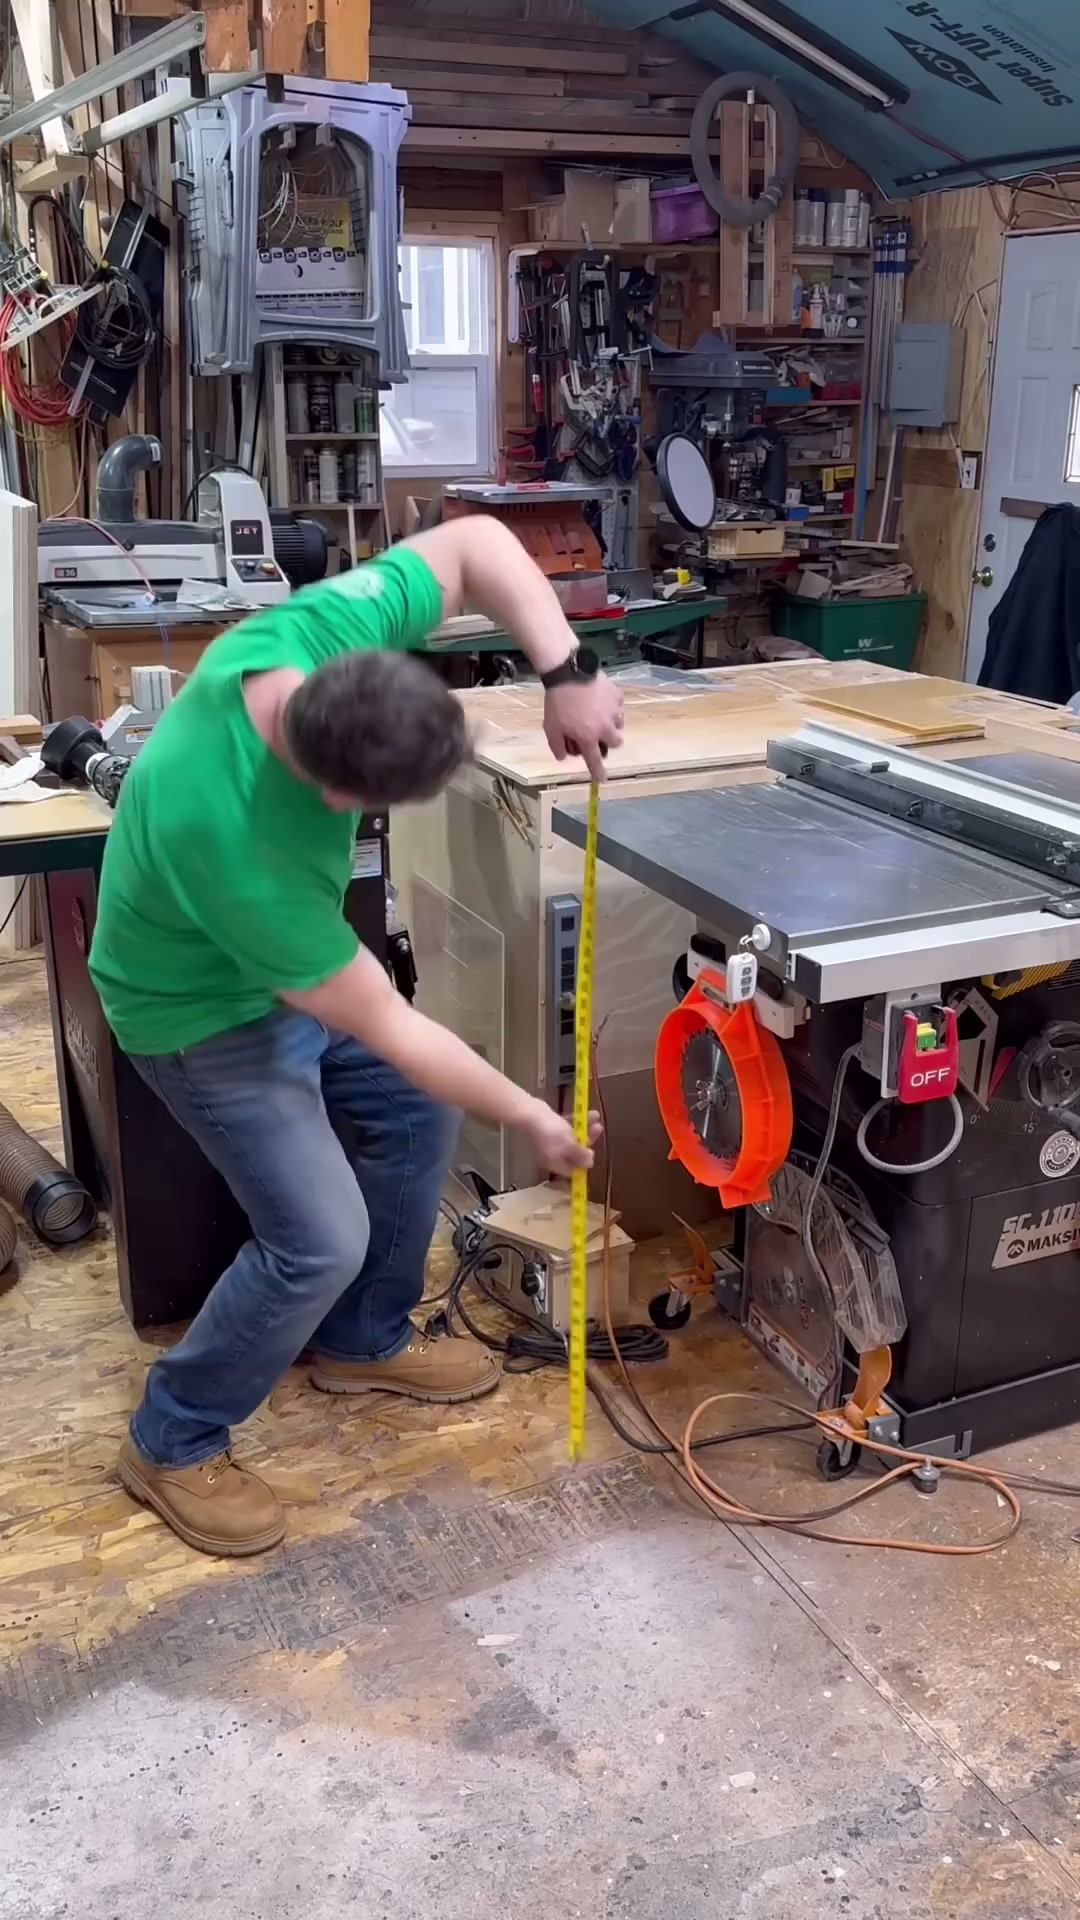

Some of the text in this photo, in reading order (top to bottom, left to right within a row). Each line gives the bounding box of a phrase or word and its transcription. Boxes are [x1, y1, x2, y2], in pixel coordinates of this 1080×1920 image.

[903, 43, 981, 89] DOW
[982, 24, 1057, 73] Insulation
[996, 60, 1074, 108] Super
[235, 527, 259, 535] JET
[910, 1067, 951, 1087] OFF
[1027, 1228, 1080, 1252] MAKSI
